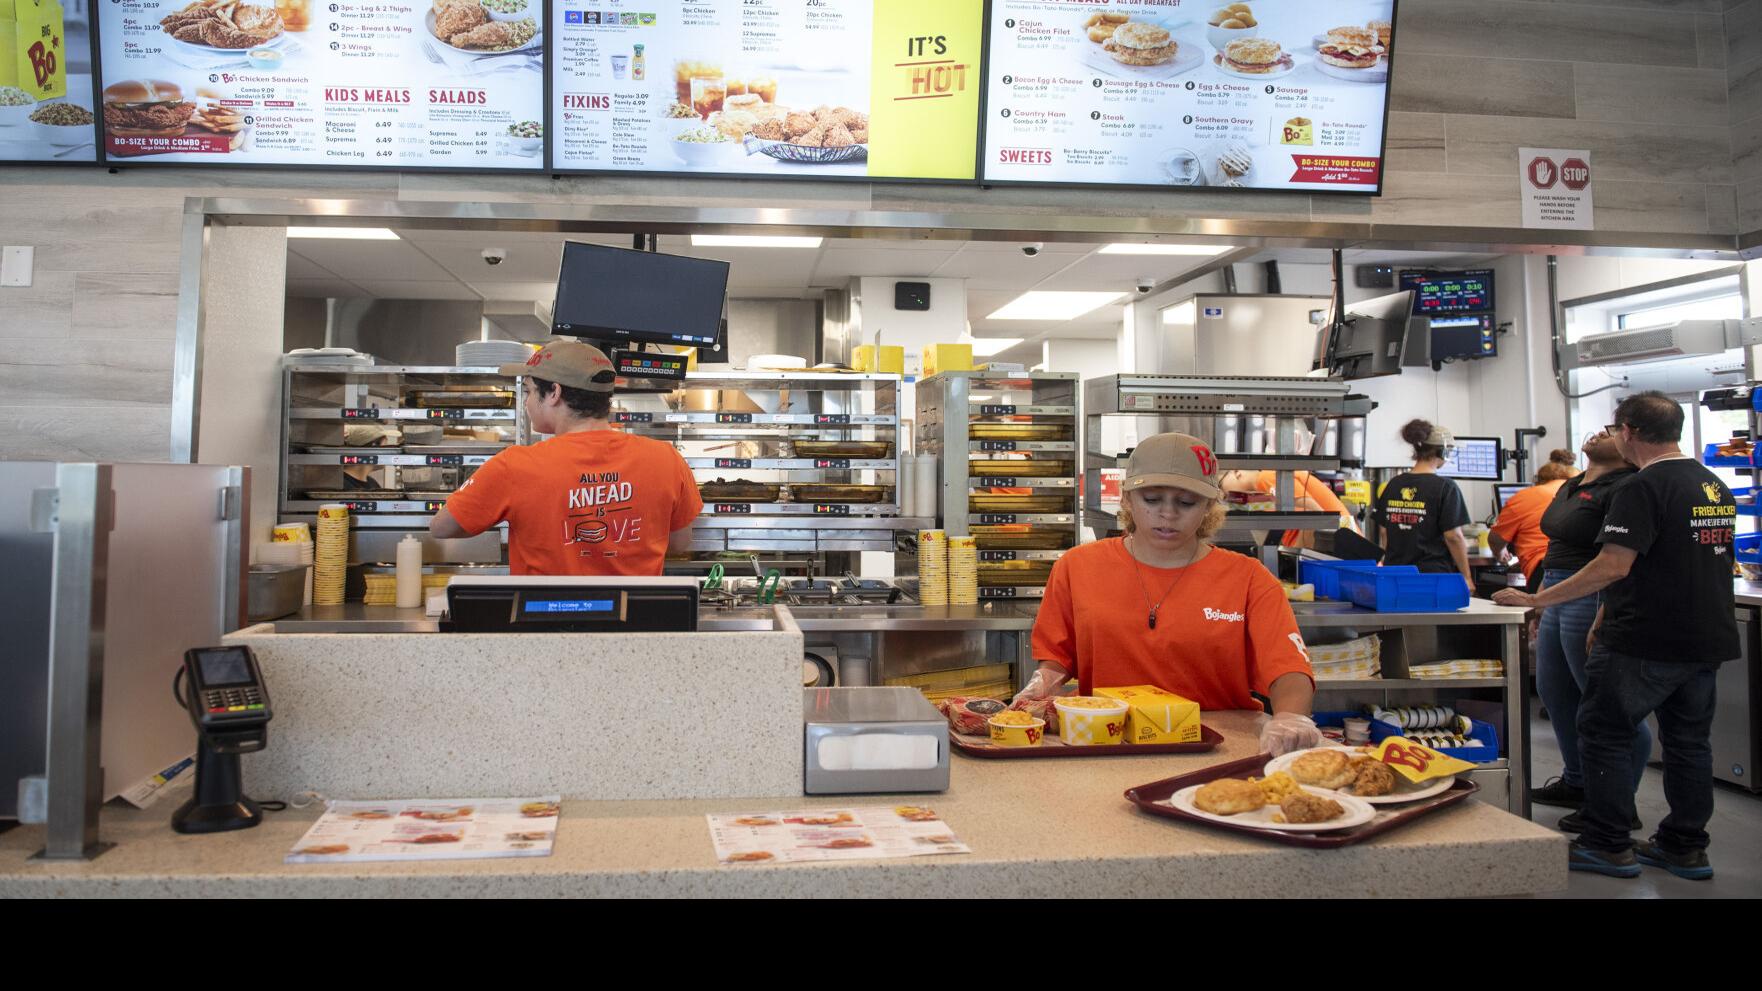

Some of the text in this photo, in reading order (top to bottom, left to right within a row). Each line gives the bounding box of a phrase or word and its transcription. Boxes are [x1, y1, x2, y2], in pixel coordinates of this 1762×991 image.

[1019, 20, 1042, 28] Cajun
[911, 64, 968, 94] HOT
[325, 89, 410, 102] KIDS MEALS
[1276, 86, 1308, 94] Sausage
[429, 90, 486, 104] SALADS
[564, 95, 609, 108] FIXINS
[1015, 110, 1046, 118] Country
[1230, 117, 1253, 126] Gravy
[1283, 127, 1300, 142] Bo
[1000, 150, 1052, 163] SWEETS
[1564, 168, 1587, 181] STOP
[580, 472, 618, 483] ALL YOU
[569, 482, 632, 509] KNEAD
[596, 508, 605, 517] IS
[1203, 608, 1244, 622] Bojangles
[1025, 728, 1040, 745] Bo
[1381, 742, 1435, 774] Bo
